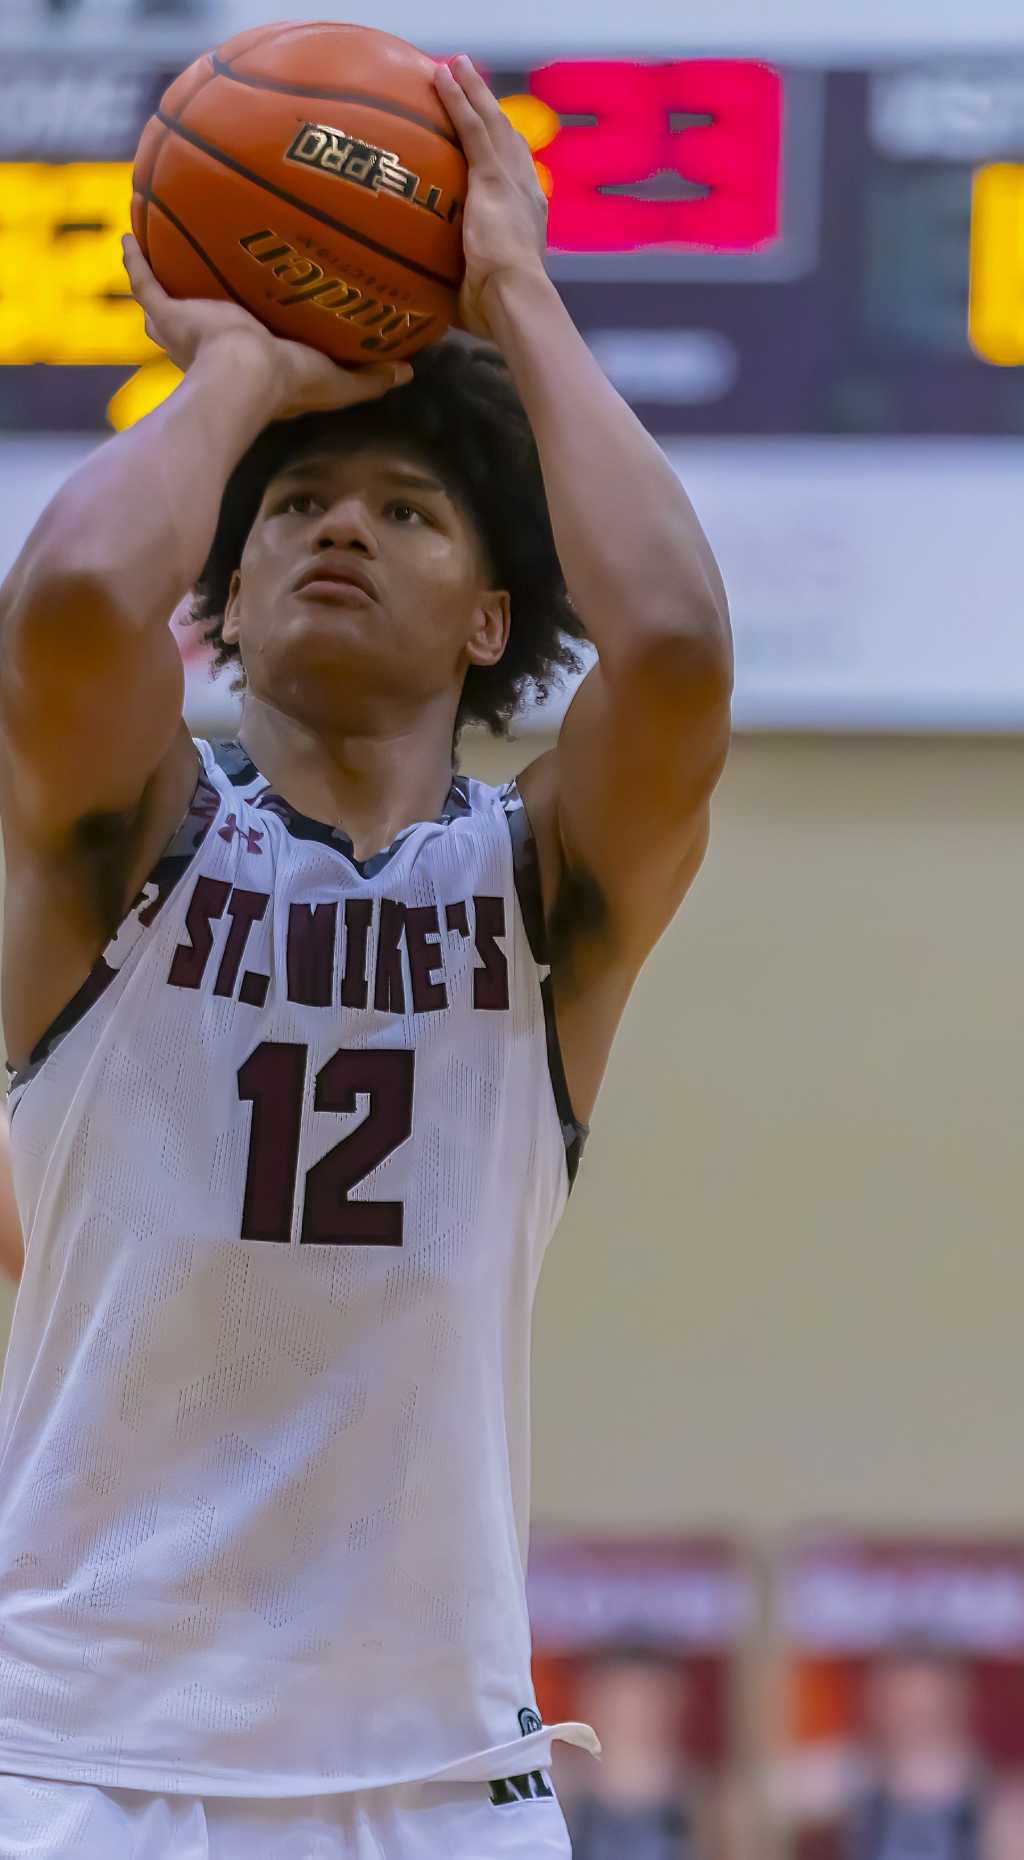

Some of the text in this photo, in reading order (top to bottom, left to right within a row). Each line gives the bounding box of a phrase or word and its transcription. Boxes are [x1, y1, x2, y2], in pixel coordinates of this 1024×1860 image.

[168, 875, 510, 1016] ST. MIKE'S
[237, 1041, 416, 1247] 12
